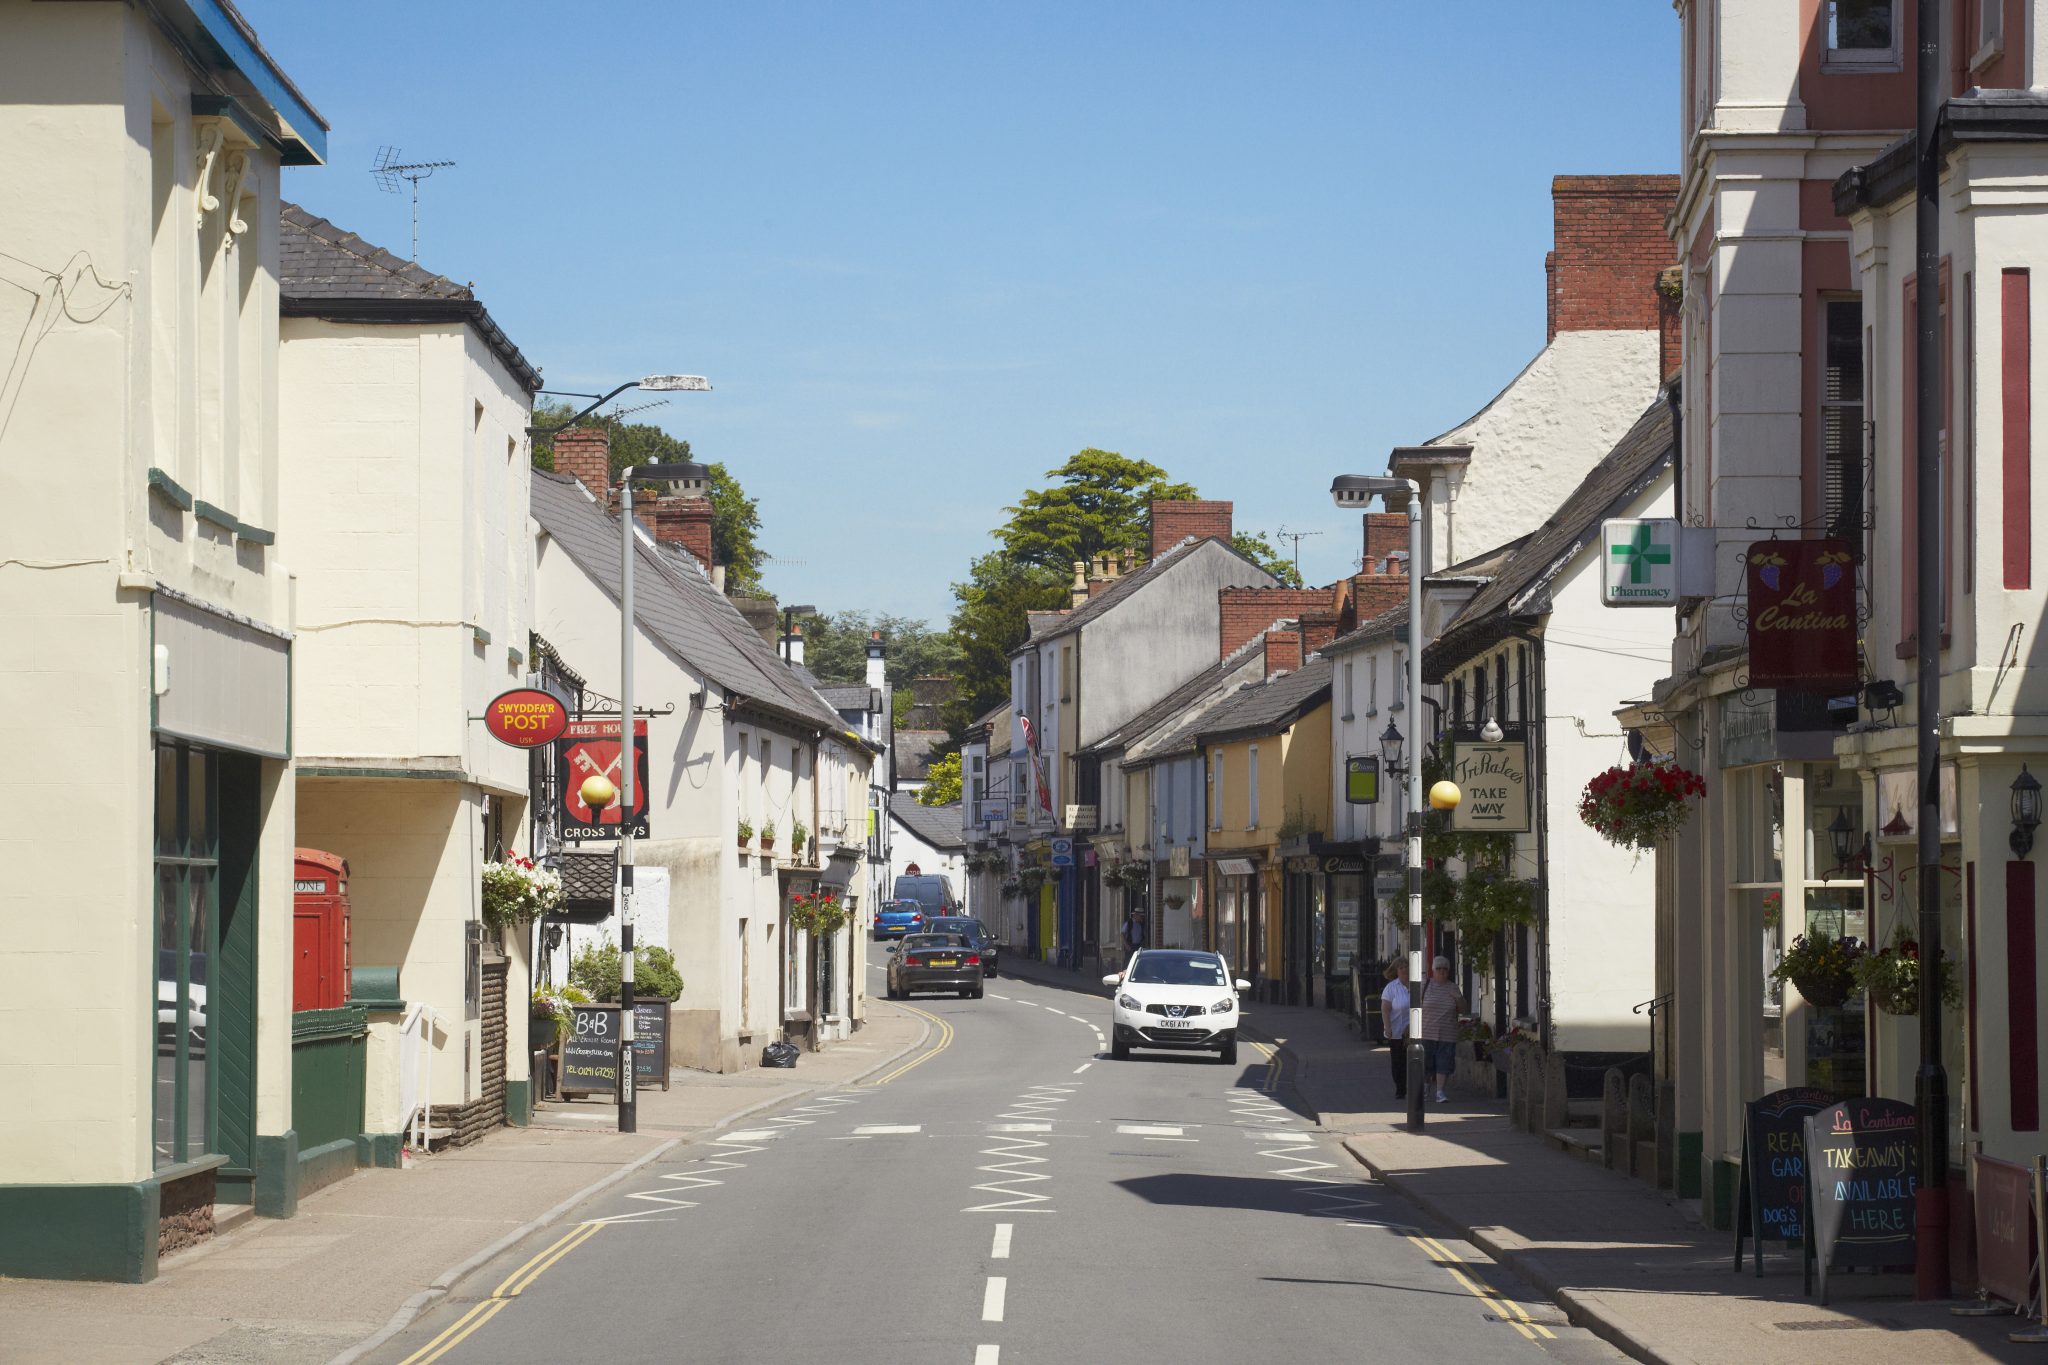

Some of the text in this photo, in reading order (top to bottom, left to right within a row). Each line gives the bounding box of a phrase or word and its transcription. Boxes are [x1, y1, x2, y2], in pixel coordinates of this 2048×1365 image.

[1611, 586, 1671, 598] Pharmacy
[1781, 582, 1818, 607] La
[1755, 605, 1849, 632] Cantina
[498, 704, 555, 714] SWYDDFA'R
[504, 715, 549, 730] POST
[570, 724, 597, 735] FREE
[1470, 787, 1507, 799] TAKE
[1471, 803, 1505, 814] AWAY
[564, 826, 646, 838] CROSS KYS
[294, 881, 322, 891] ONE
[576, 1011, 608, 1036] B&B
[1161, 1020, 1191, 1028] CK61 AYY
[1833, 1107, 1916, 1131] La Cantina
[1767, 1131, 1804, 1152] REA
[1772, 1157, 1804, 1177] GAR
[1835, 1176, 1916, 1201] AVAILABLE
[1852, 1208, 1905, 1231] HERE
